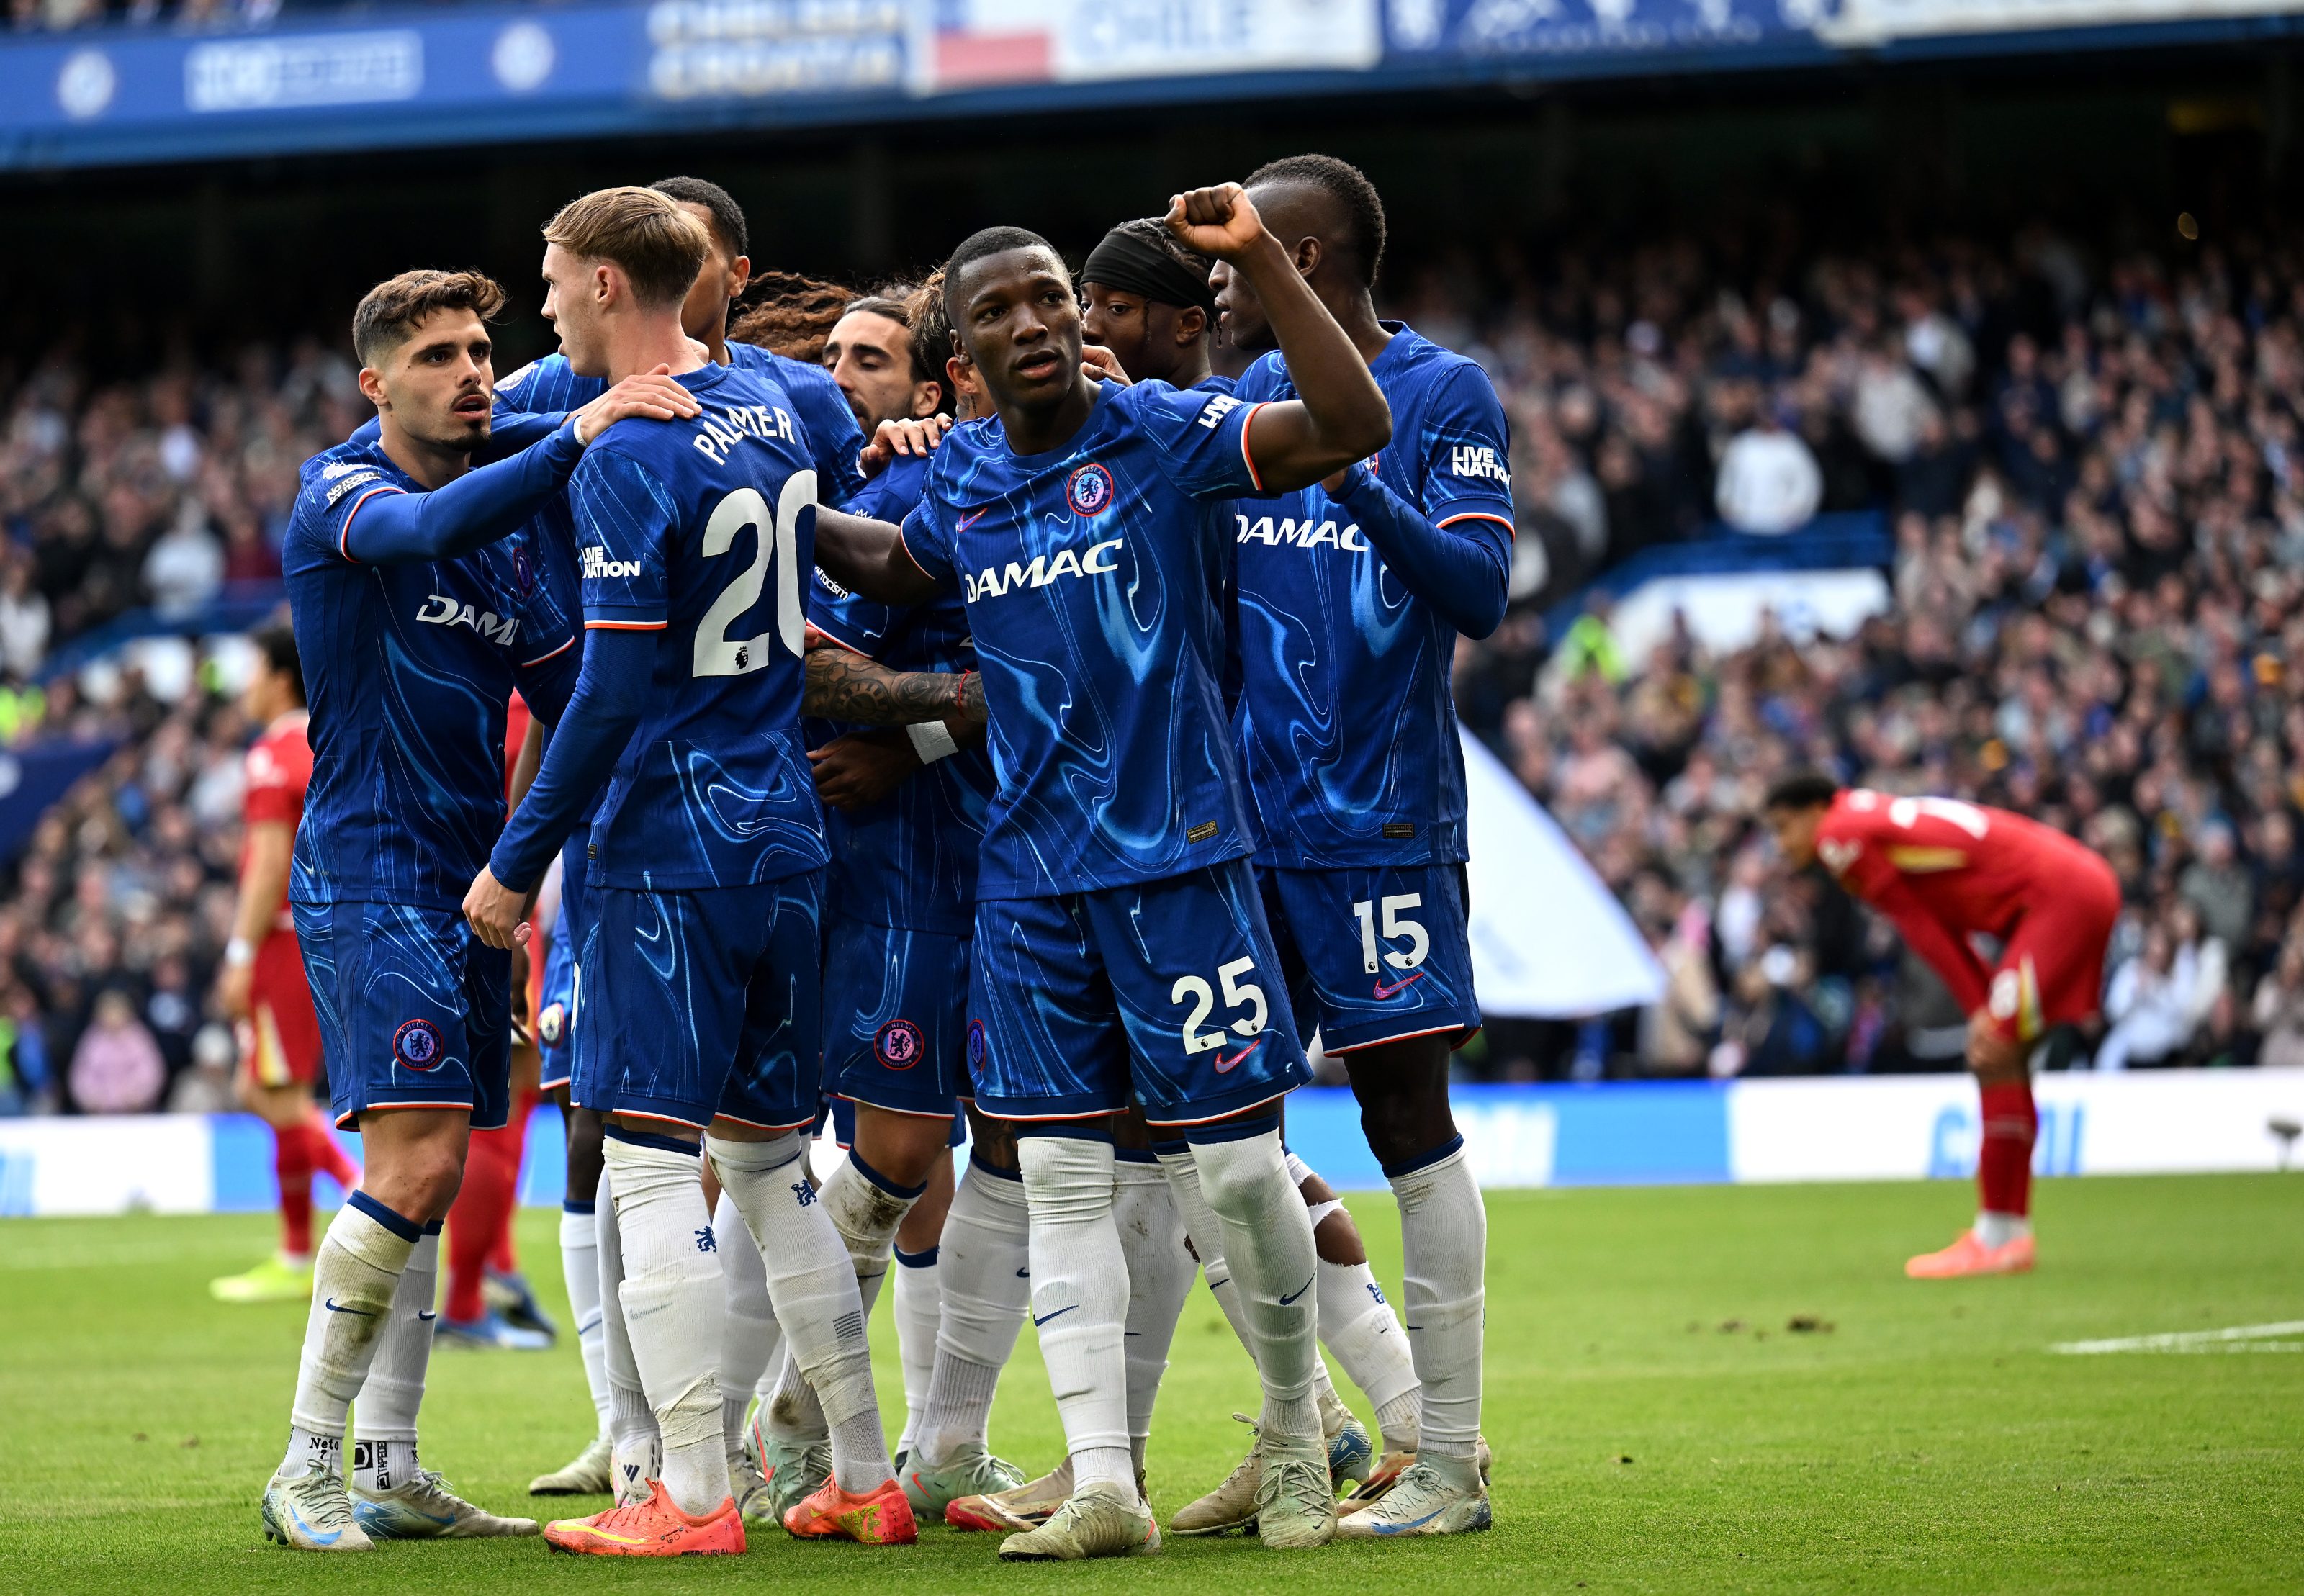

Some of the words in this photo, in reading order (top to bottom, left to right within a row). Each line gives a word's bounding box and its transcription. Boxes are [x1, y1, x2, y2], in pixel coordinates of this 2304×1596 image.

[693, 405, 796, 466] PALMER
[1452, 446, 1494, 464] LIVE
[1074, 466, 1102, 479] CHELSEA
[1452, 461, 1511, 488] NATION
[327, 484, 341, 503] No
[342, 472, 374, 487] room
[343, 476, 382, 492] racism
[580, 546, 603, 564] LIVE
[582, 560, 641, 579] NATION
[692, 469, 818, 677] 20
[965, 538, 1124, 604] DAMAC
[819, 573, 849, 600] racism
[1354, 893, 1430, 974] 15
[1171, 955, 1269, 1055] 25
[402, 1022, 433, 1033] CHELSEA
[886, 1022, 916, 1036] CHELSEA
[309, 1437, 339, 1451] Neto
[320, 1449, 328, 1459] 7
